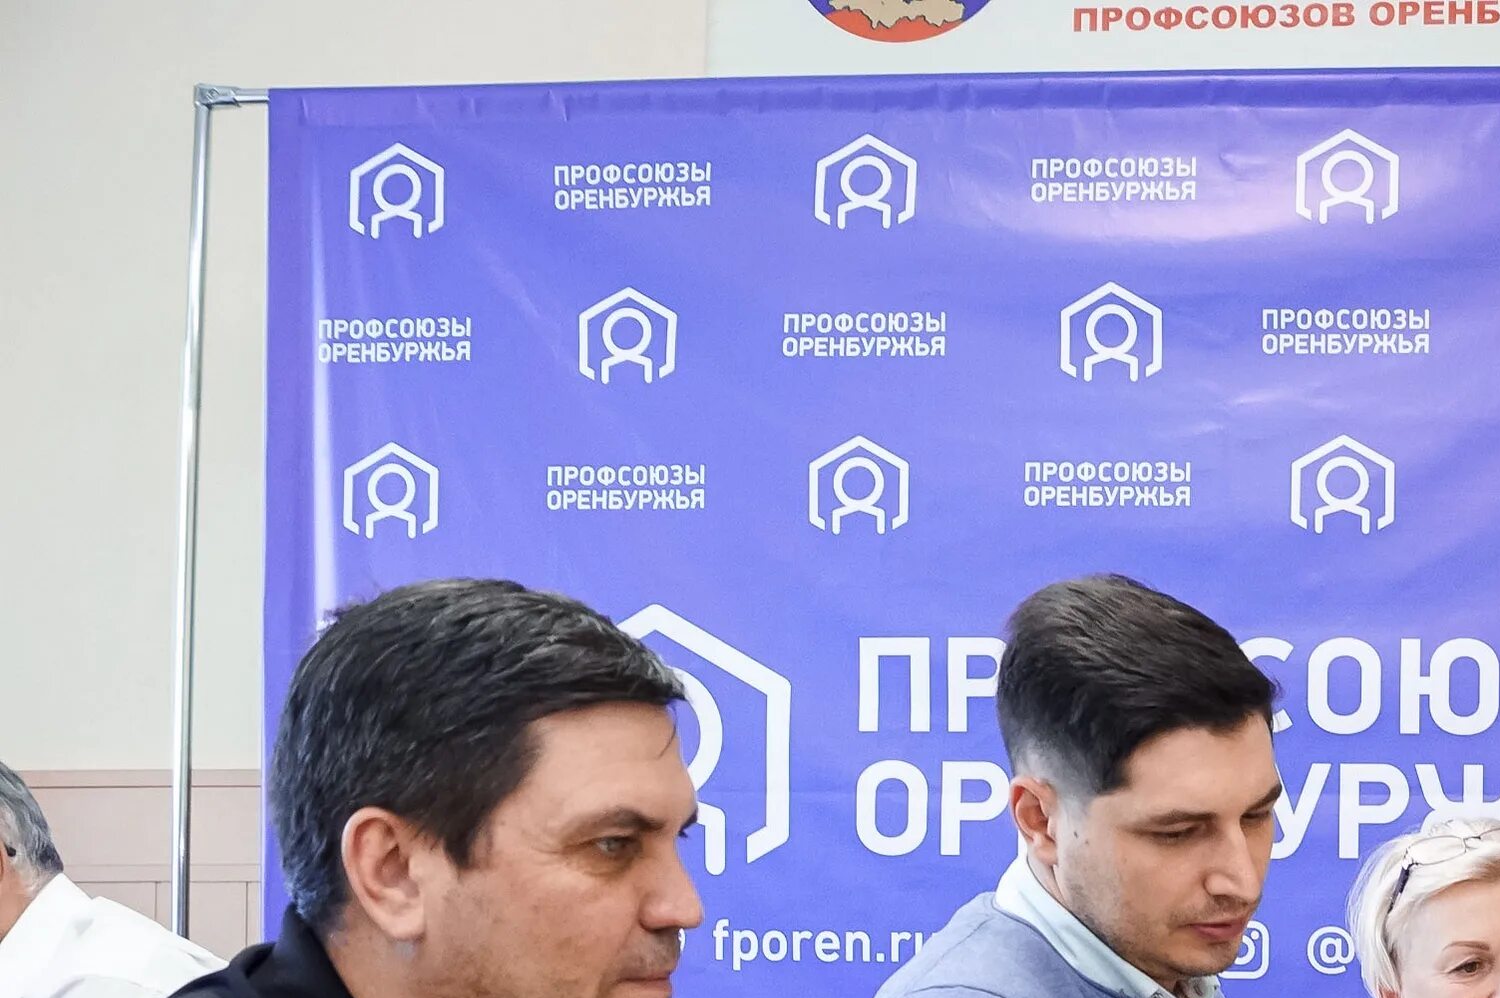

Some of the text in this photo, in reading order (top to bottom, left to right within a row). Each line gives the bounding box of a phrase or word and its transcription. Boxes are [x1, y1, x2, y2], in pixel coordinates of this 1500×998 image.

[1072, 3, 1356, 32] ПРОФСОЮЗОВ
[555, 161, 712, 187] ПРОФСОЮЗЫ
[1032, 157, 1197, 179] ПРОФСОЮЗЫ
[554, 185, 711, 211] ОРЕНБУРЖЬЯ
[1032, 181, 1196, 203] ОРЕНБУРЖЬЯ
[318, 317, 472, 340] ПРОФСОЮЗЫ
[783, 311, 946, 334] ПРОФСОЮЗЫ
[1262, 309, 1430, 330] ПРОФСОЮЗЫ
[318, 341, 471, 364] ОРЕНБУРЖЬЯ
[782, 335, 946, 357] ОРЕНБУРЖЬЯ
[1262, 333, 1430, 355] ОРЕНБУРЖЬЯ
[547, 464, 706, 487] ПРОФСОЮЗЫ
[1025, 462, 1191, 483] ПРОФСОЮЗЫ
[546, 488, 705, 511] ОРЕНБУРЖЬЯ
[1024, 485, 1191, 507] ОРЕНБУРЖЬЯ
